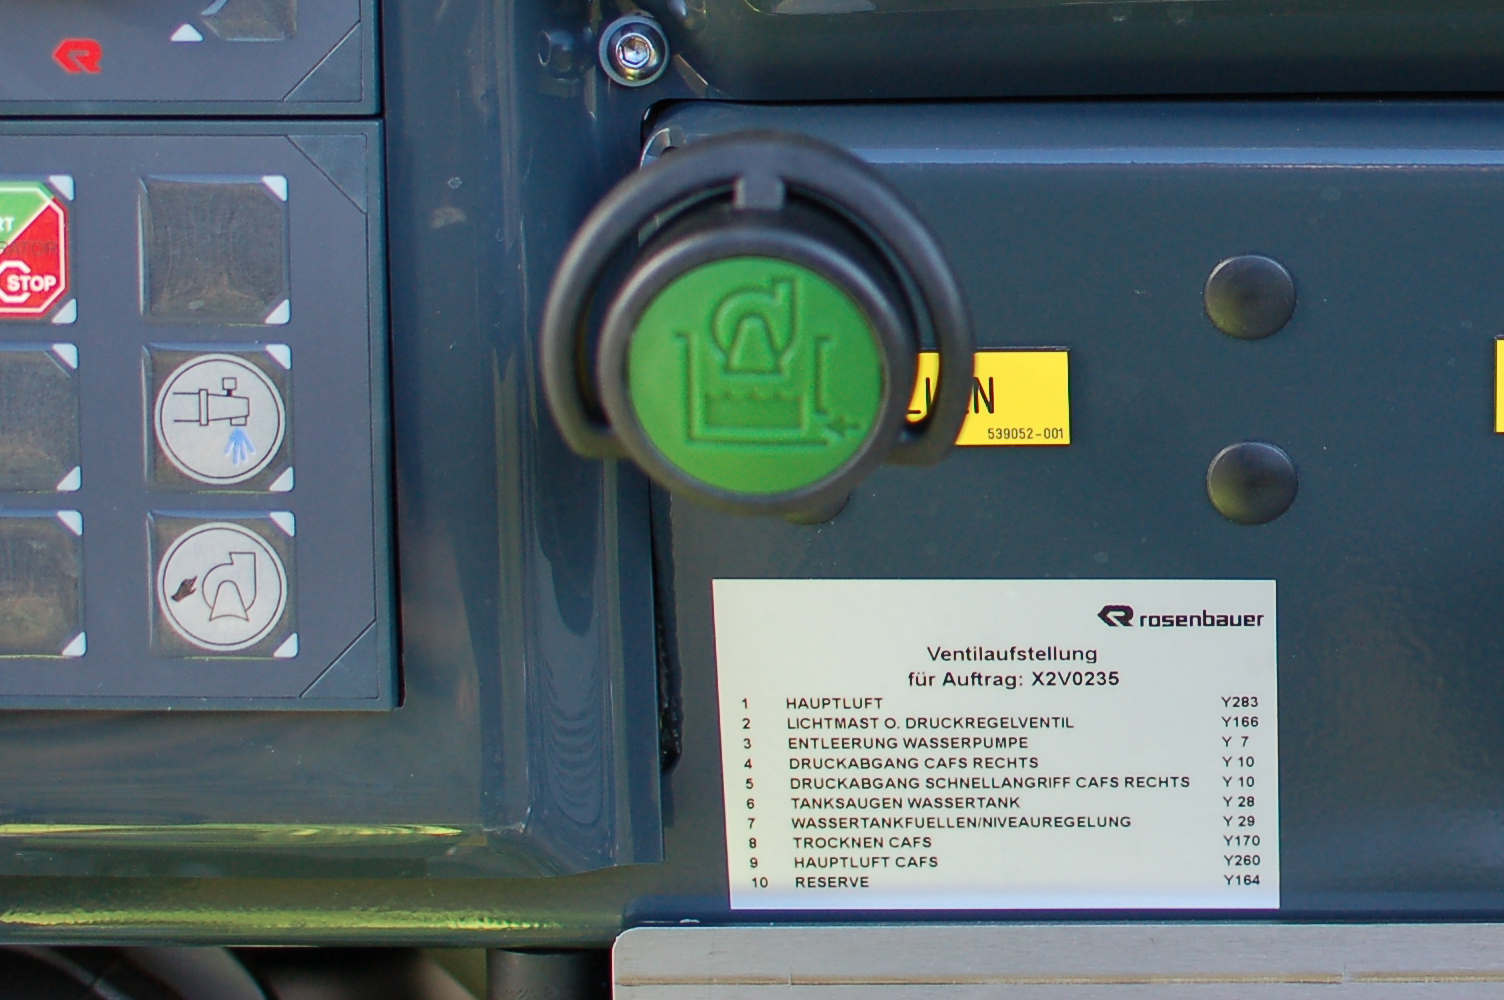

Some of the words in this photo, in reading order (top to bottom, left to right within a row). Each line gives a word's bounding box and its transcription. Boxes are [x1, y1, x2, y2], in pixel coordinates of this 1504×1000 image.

[7, 274, 57, 292] STOP
[987, 428, 1064, 440] 539052-001
[1139, 610, 1265, 628] rosenbauer
[927, 645, 1098, 664] Ventilaufstellung
[908, 671, 936, 687] für
[942, 671, 1024, 690] Auftrag:
[1031, 671, 1120, 687] X2V0235
[742, 698, 748, 709] 1
[786, 697, 883, 709] HAUPTLUFT
[1221, 696, 1258, 707] Y283
[742, 718, 750, 729] 2
[787, 717, 879, 729] LICHTMAST
[884, 717, 900, 729] O.
[905, 716, 1075, 730] DRUCKREGELVENTIL
[1221, 716, 1258, 727] Y166
[743, 738, 751, 749] 3
[788, 737, 898, 750] ENTLEERUNG
[903, 736, 1029, 749] WASSERPUMPE
[1222, 736, 1232, 747] Y
[1241, 736, 1249, 747] 7
[744, 758, 752, 769] 4
[789, 757, 919, 770] DRUCKABGANG
[924, 757, 967, 769] CAFS
[973, 756, 1039, 769] RECHTS
[1222, 756, 1232, 767] Y
[1238, 756, 1254, 767] 10
[746, 778, 754, 789] 5
[790, 777, 920, 789] DRUCKABGANG
[925, 776, 1071, 789] SCHNELLANGRIFF
[1076, 775, 1120, 788] CAFS
[1124, 775, 1190, 788] RECHTS
[1222, 776, 1232, 787] Y
[1238, 776, 1254, 787] 10
[746, 798, 754, 809] 6
[791, 797, 903, 809] TANKSAUGEN
[907, 796, 1021, 809] WASSERTANK
[1223, 796, 1233, 807] Y
[1237, 796, 1255, 807] 28
[748, 817, 755, 829] 7
[791, 816, 1132, 829] WASSERTANKFUELLEN/NIVEAUREGELUNG
[1223, 816, 1233, 826] Y
[1238, 816, 1255, 826] 29
[749, 837, 757, 848] 8
[793, 837, 884, 848] TROCKNEN
[889, 836, 932, 848] CAFS
[1223, 835, 1260, 846] Y170
[750, 857, 758, 868] 9
[794, 856, 889, 868] HAUPTLUFT
[895, 856, 938, 868] CAFS
[1224, 855, 1261, 866] Y260
[752, 877, 768, 888] 10
[795, 877, 869, 888] RESERVE
[1224, 875, 1260, 885] Y164
